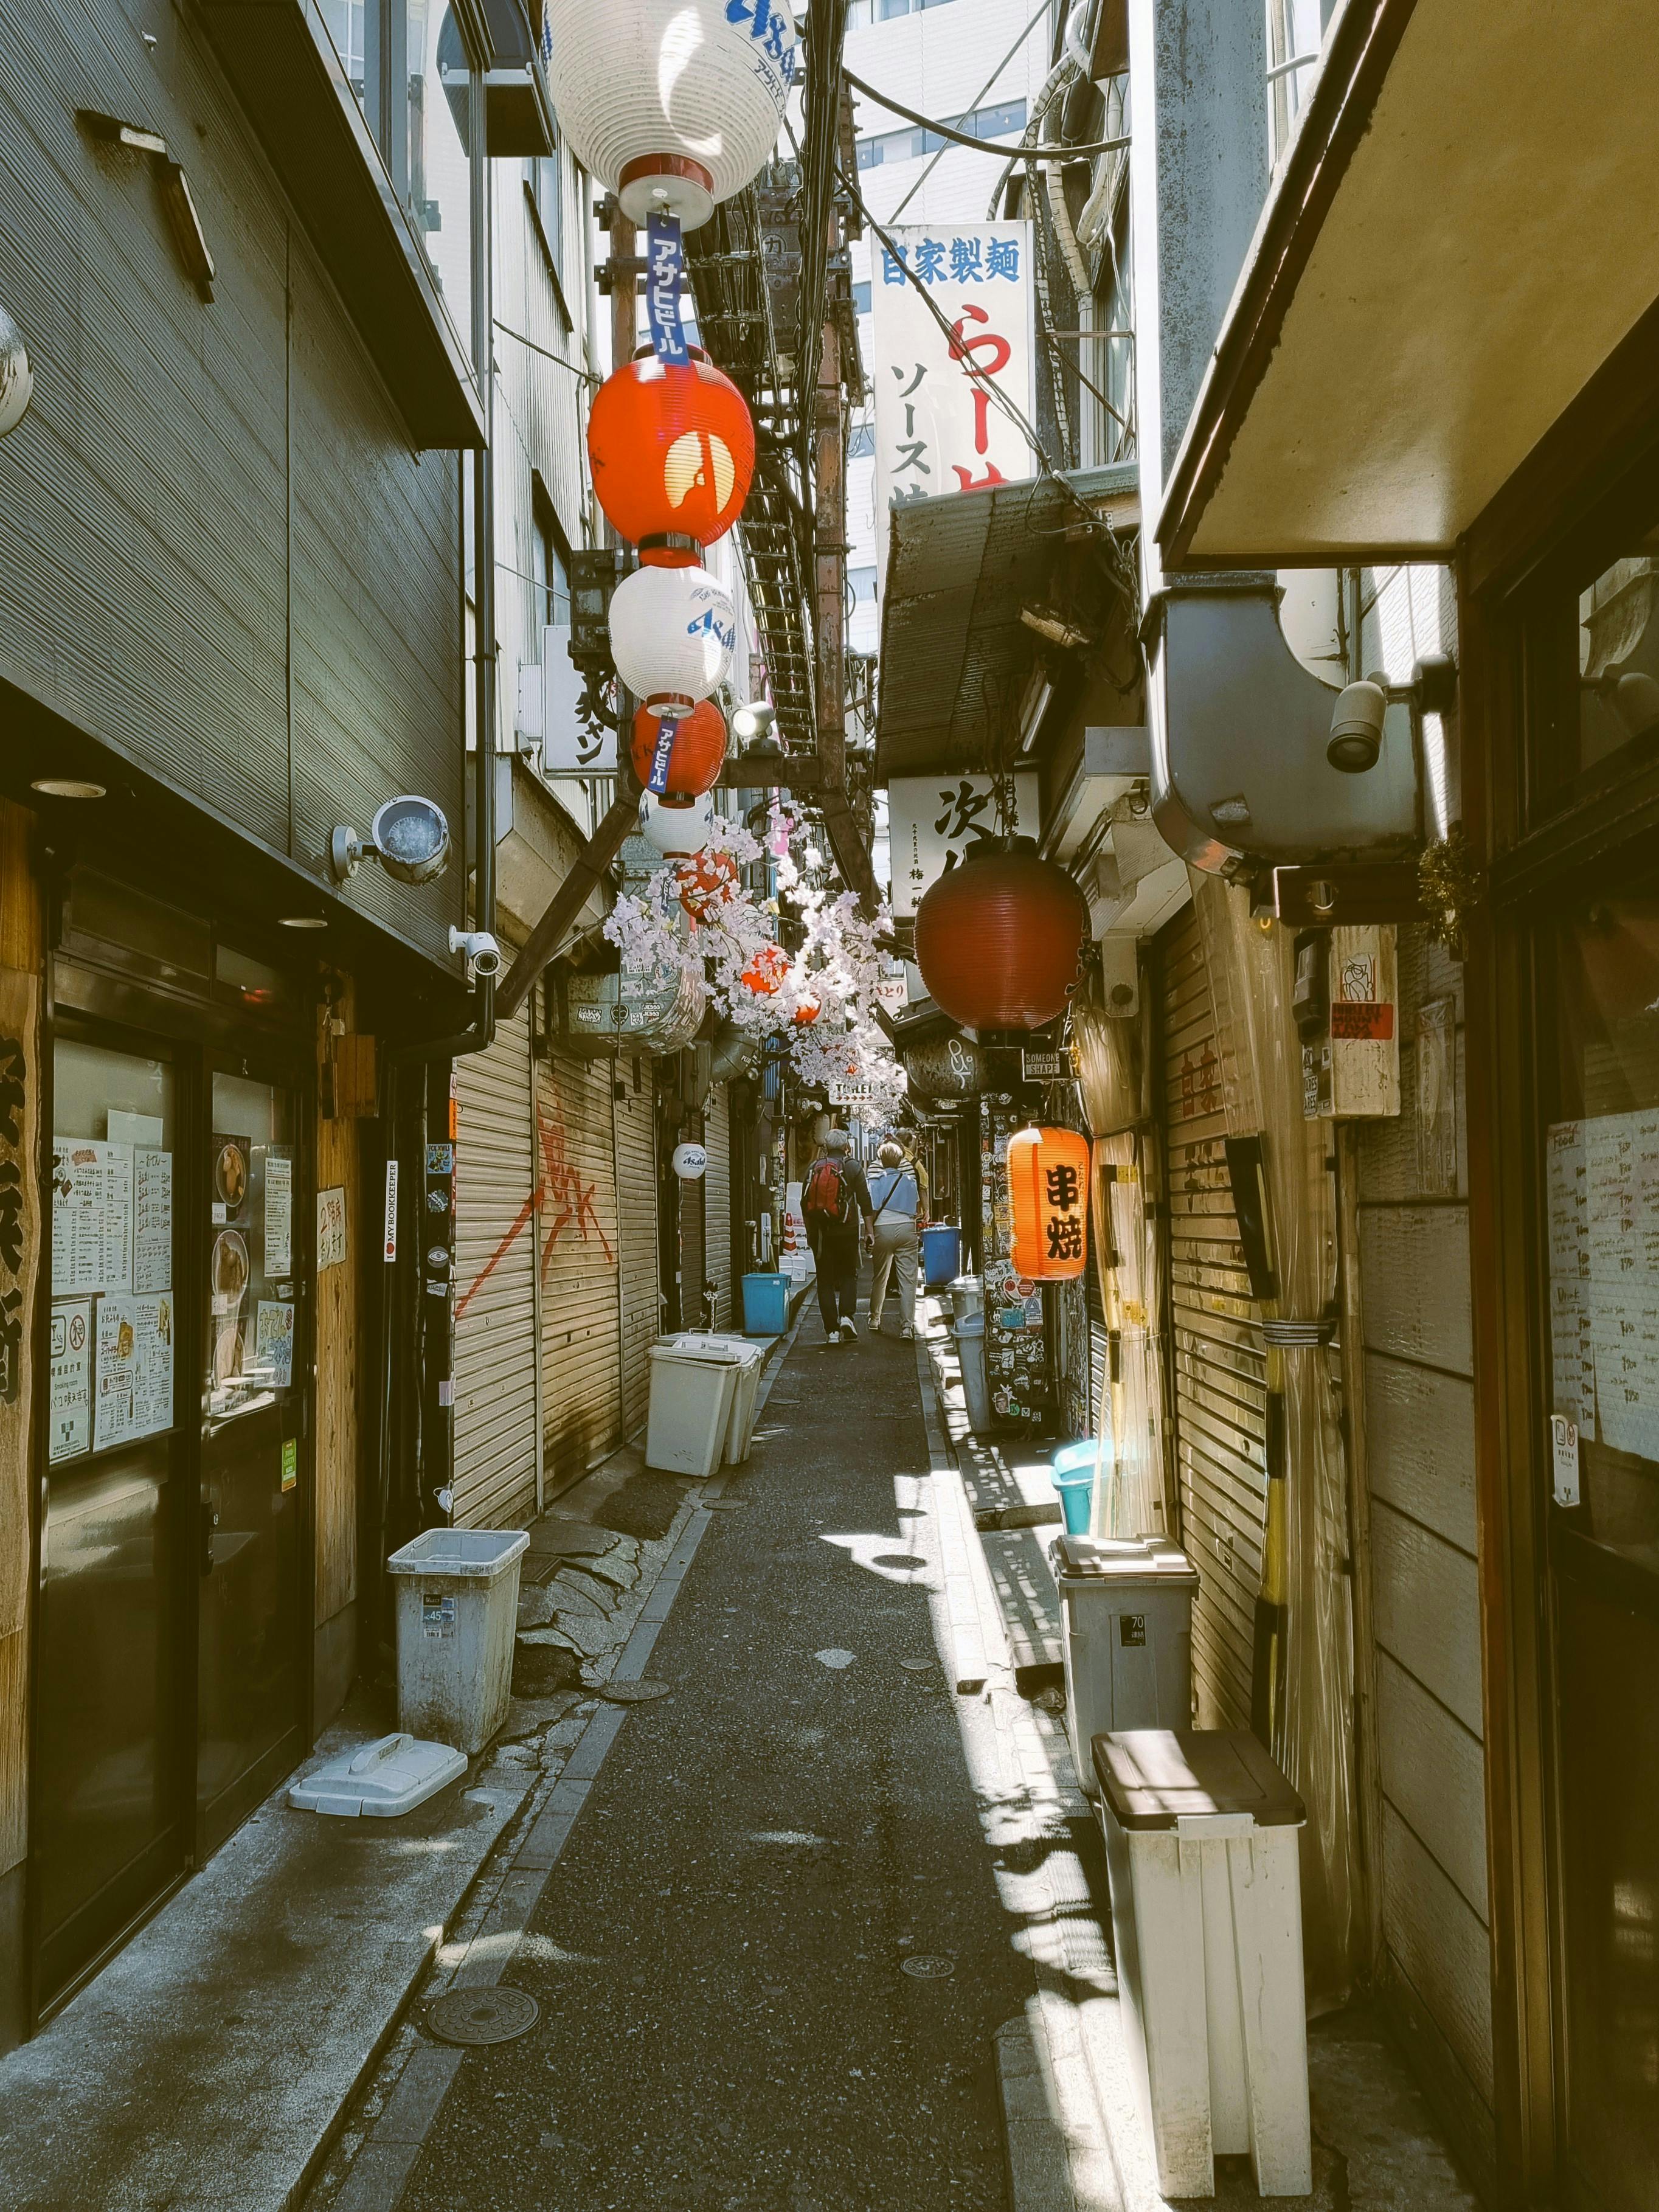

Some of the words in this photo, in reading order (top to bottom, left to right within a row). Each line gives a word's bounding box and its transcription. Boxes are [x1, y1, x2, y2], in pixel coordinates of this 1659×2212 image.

[882, 237, 1020, 286] 自家製麺
[653, 237, 682, 355] アサヒビール
[651, 728, 674, 786] アサヒビール
[1026, 1053, 1059, 1063] SOMEONE
[1031, 1064, 1056, 1074] SHAPE
[836, 1084, 871, 1094] TLE
[1045, 1164, 1082, 1260] 串焼
[388, 1226, 394, 1241] MY
[260, 1308, 286, 1339] おでん
[54, 1382, 69, 1390] Smoking
[1131, 1616, 1143, 1628] 70
